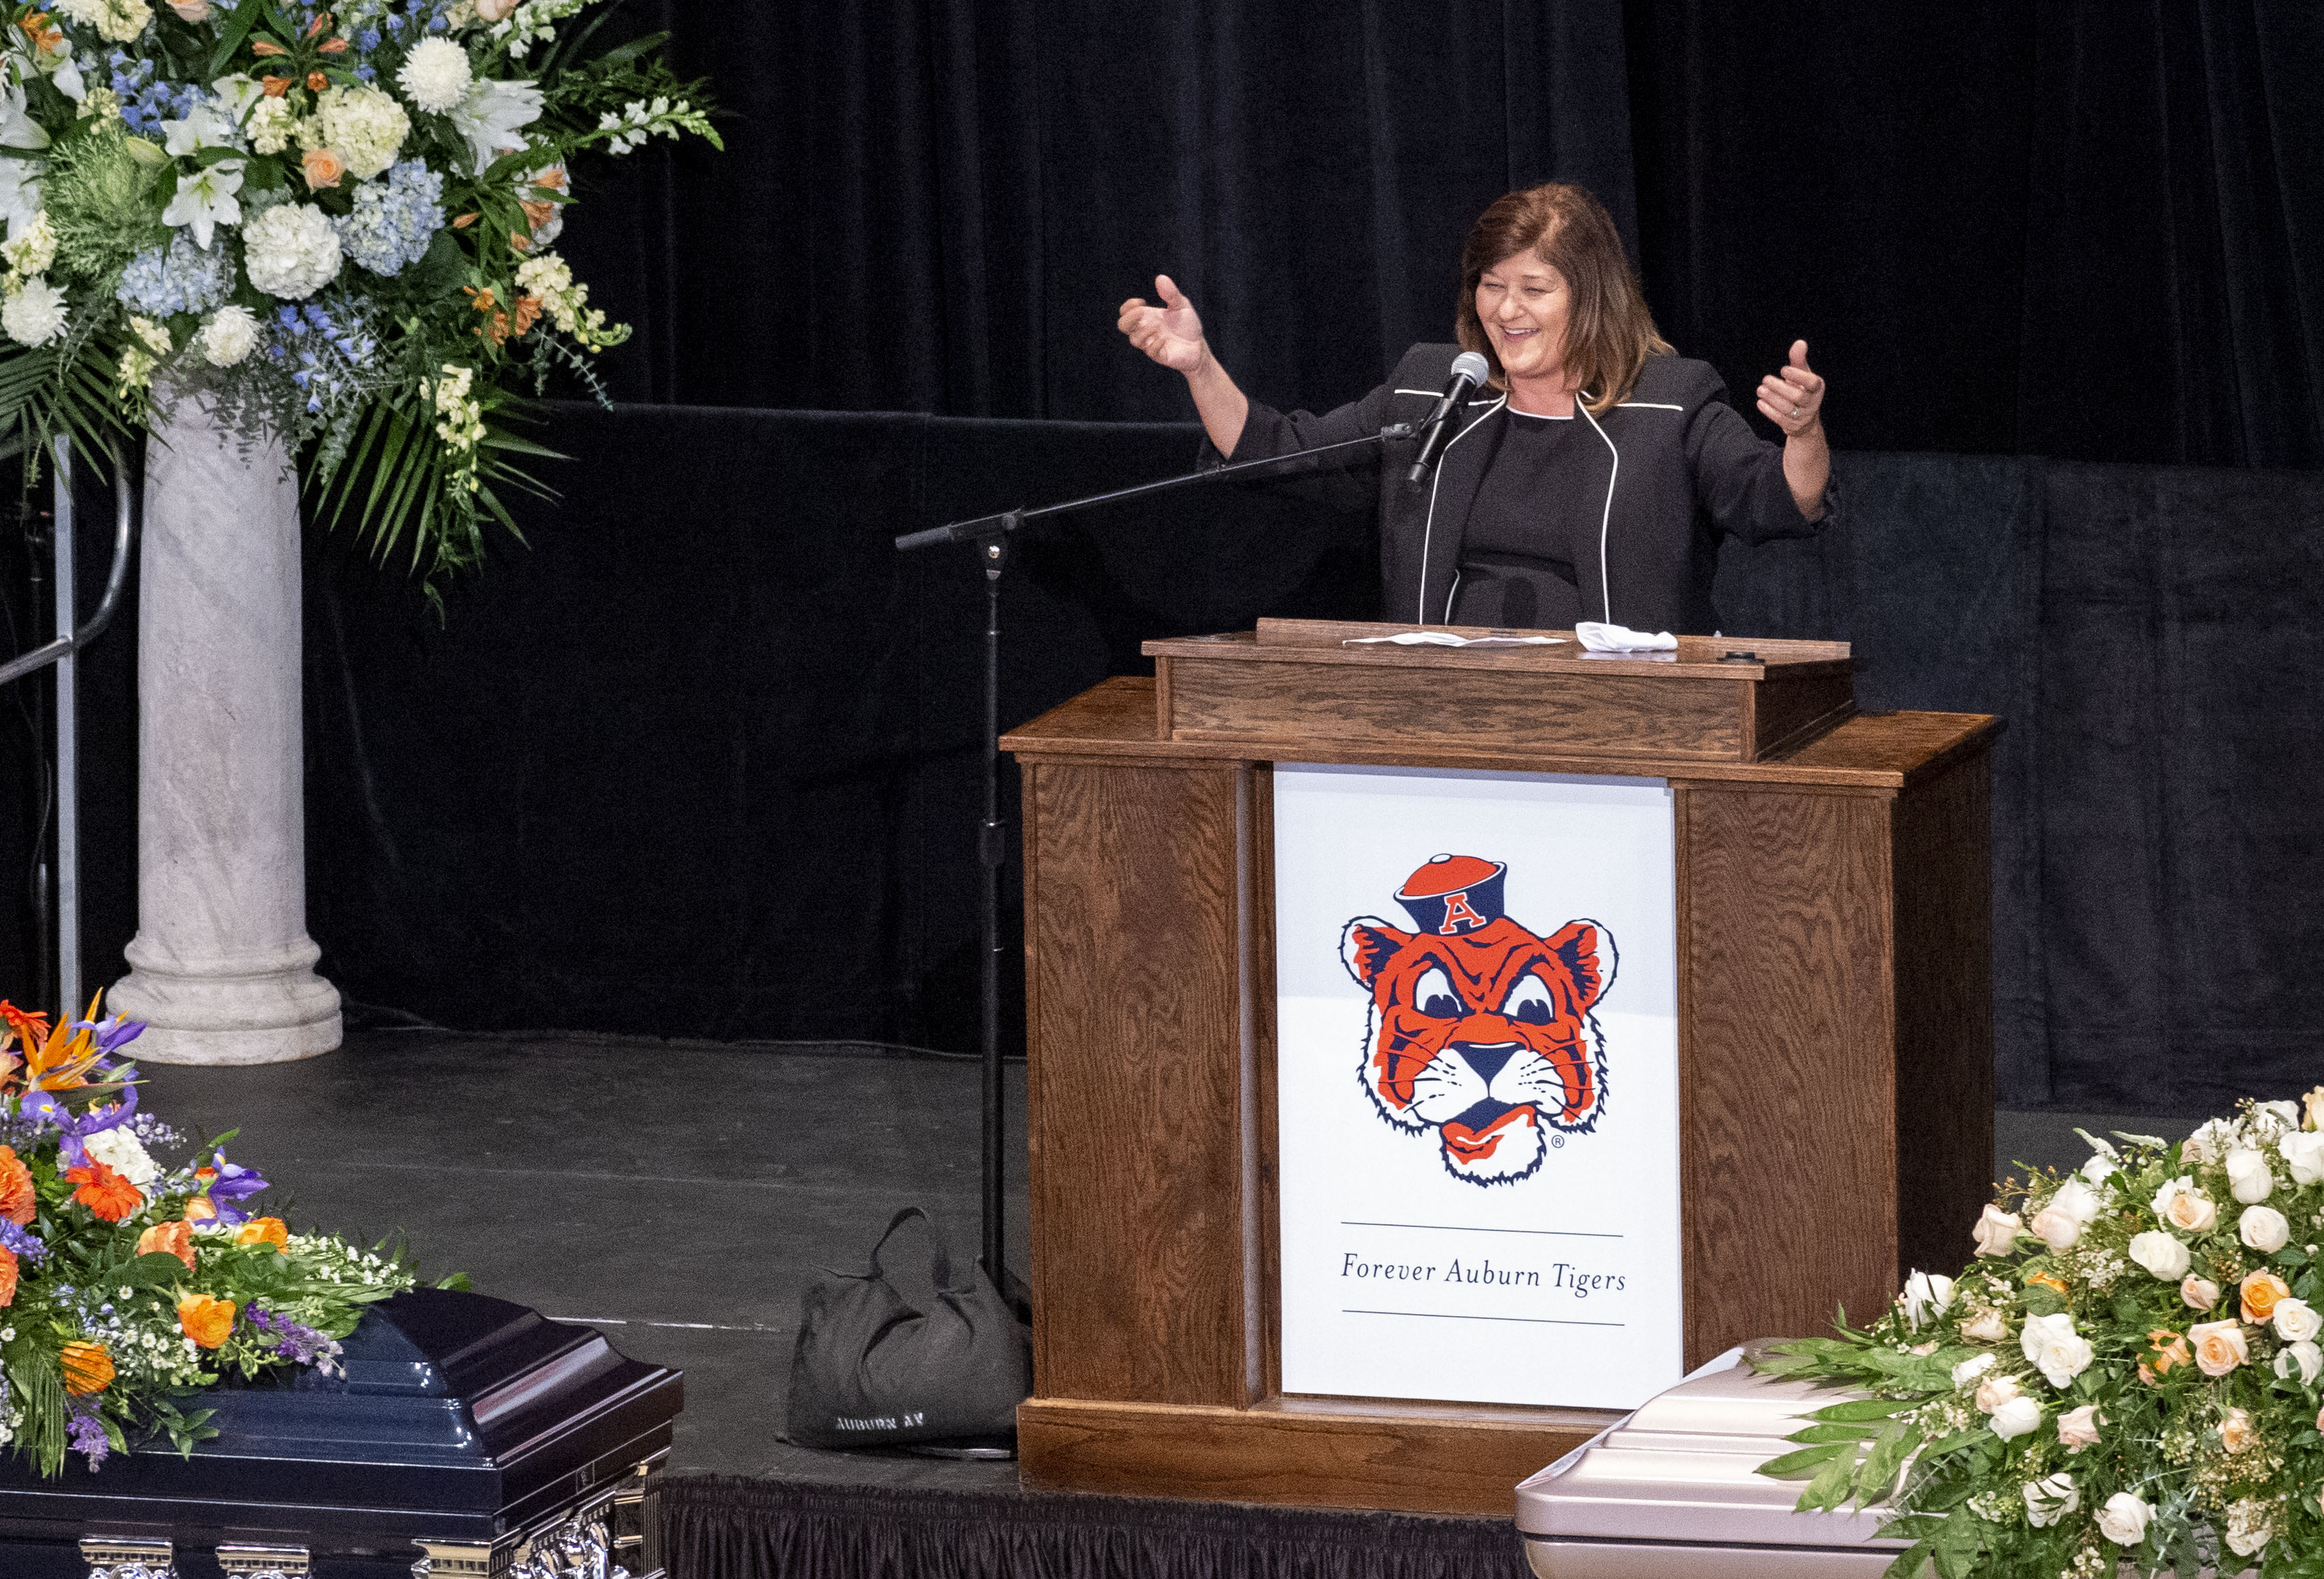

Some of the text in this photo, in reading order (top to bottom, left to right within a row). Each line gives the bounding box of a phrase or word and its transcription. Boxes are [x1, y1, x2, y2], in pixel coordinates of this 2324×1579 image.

[1438, 891, 1487, 935] A
[1340, 1252, 1626, 1298] Forever Auburn Tigers
[837, 1416, 897, 1431] AUBURN
